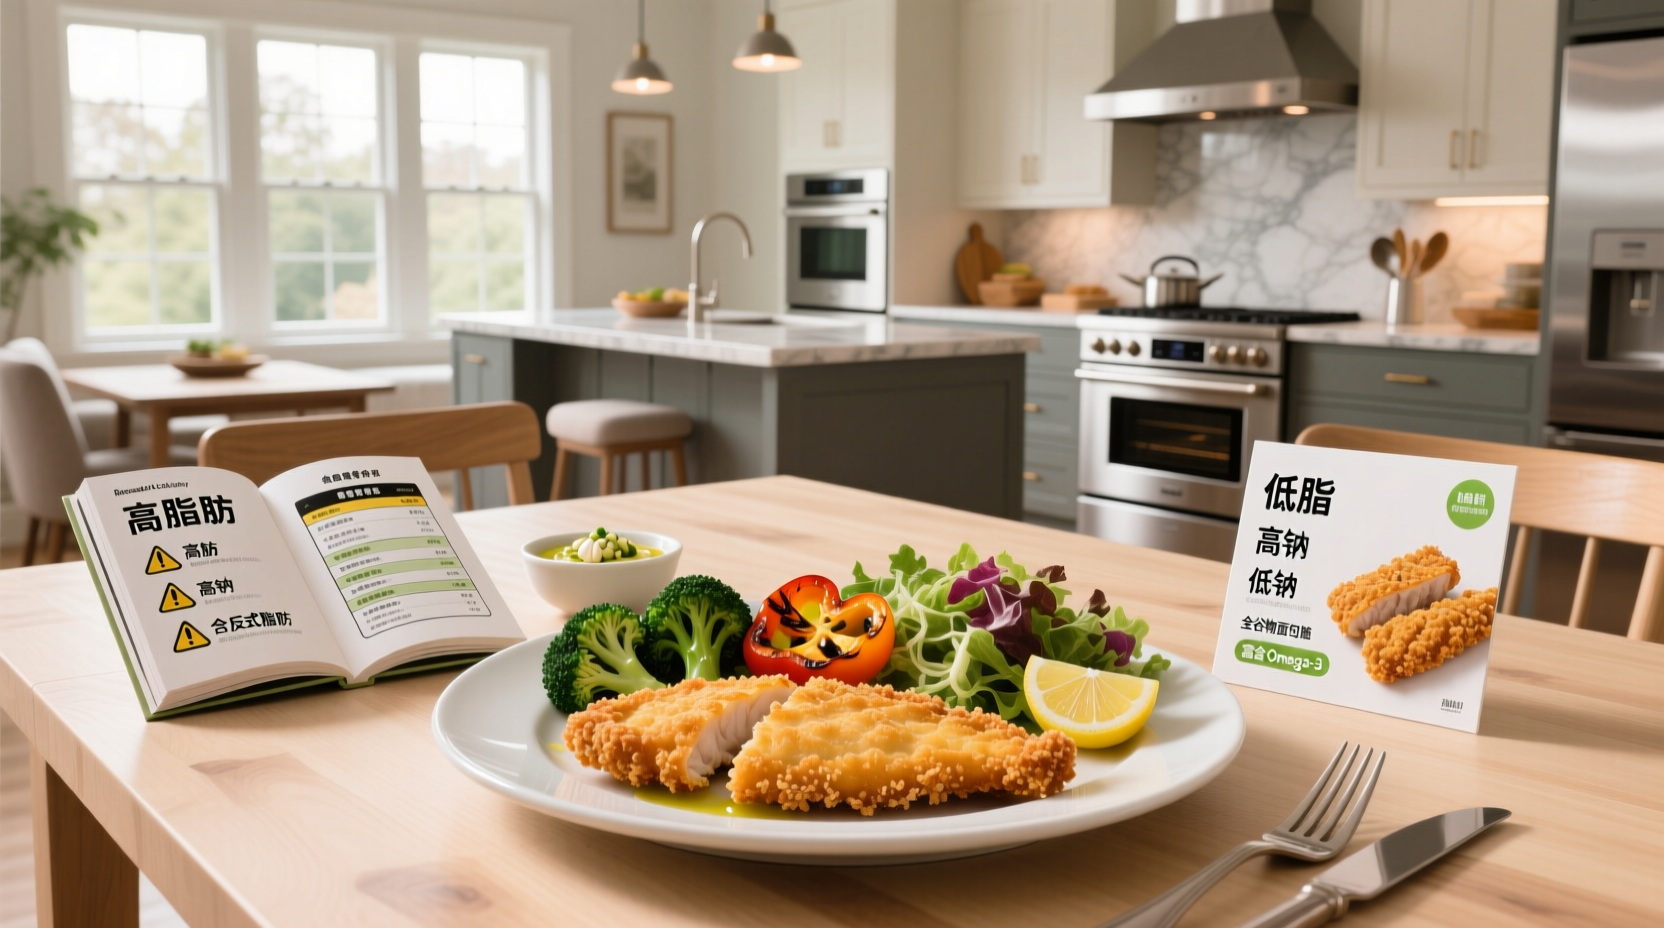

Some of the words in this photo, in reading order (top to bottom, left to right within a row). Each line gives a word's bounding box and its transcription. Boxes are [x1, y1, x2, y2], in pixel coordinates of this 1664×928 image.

[1264, 473, 1336, 516] 低脂
[122, 495, 236, 535] 高脂肪
[1256, 526, 1309, 560] 高钠
[1248, 567, 1298, 599] 低钠
